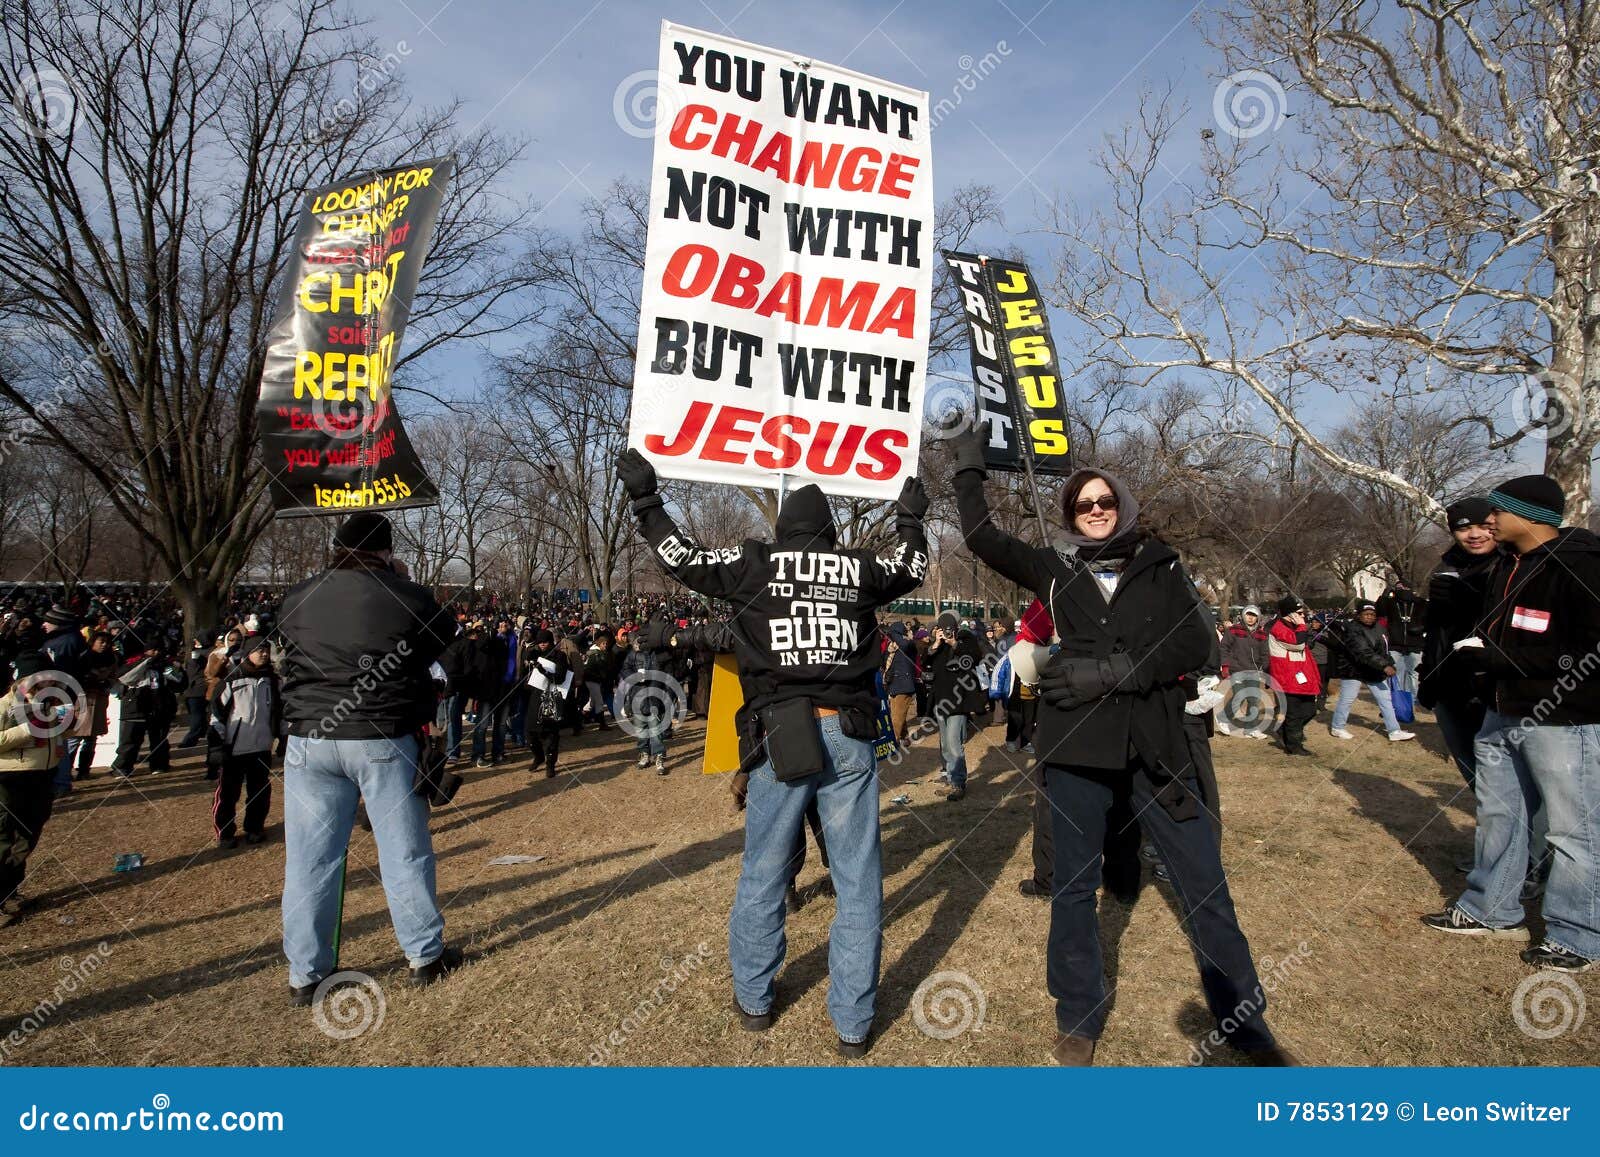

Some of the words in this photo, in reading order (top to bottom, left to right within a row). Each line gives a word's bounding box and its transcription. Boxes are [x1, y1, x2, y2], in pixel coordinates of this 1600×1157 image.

[674, 41, 765, 102] YOU
[780, 68, 918, 140] WANT
[312, 177, 392, 213] LOOKIN'
[393, 168, 433, 194] FOR
[669, 104, 920, 199] CHANGE
[664, 167, 770, 241] NOT
[784, 202, 921, 268] WITH
[661, 244, 916, 339] OBAMA
[650, 316, 763, 388] BUT
[778, 343, 915, 413] WITH
[947, 259, 1013, 449] TRUST
[996, 269, 1069, 456] JESUS
[284, 448, 320, 473] you
[644, 400, 909, 481] JESUS
[314, 482, 375, 508] Isaiah
[373, 474, 411, 504] 55:6
[768, 582, 794, 597] TO
[800, 585, 859, 602] JESUS
[769, 551, 861, 587] TURN
[769, 617, 859, 651] BURN
[780, 651, 800, 666] IN
[806, 650, 849, 666] HELL
